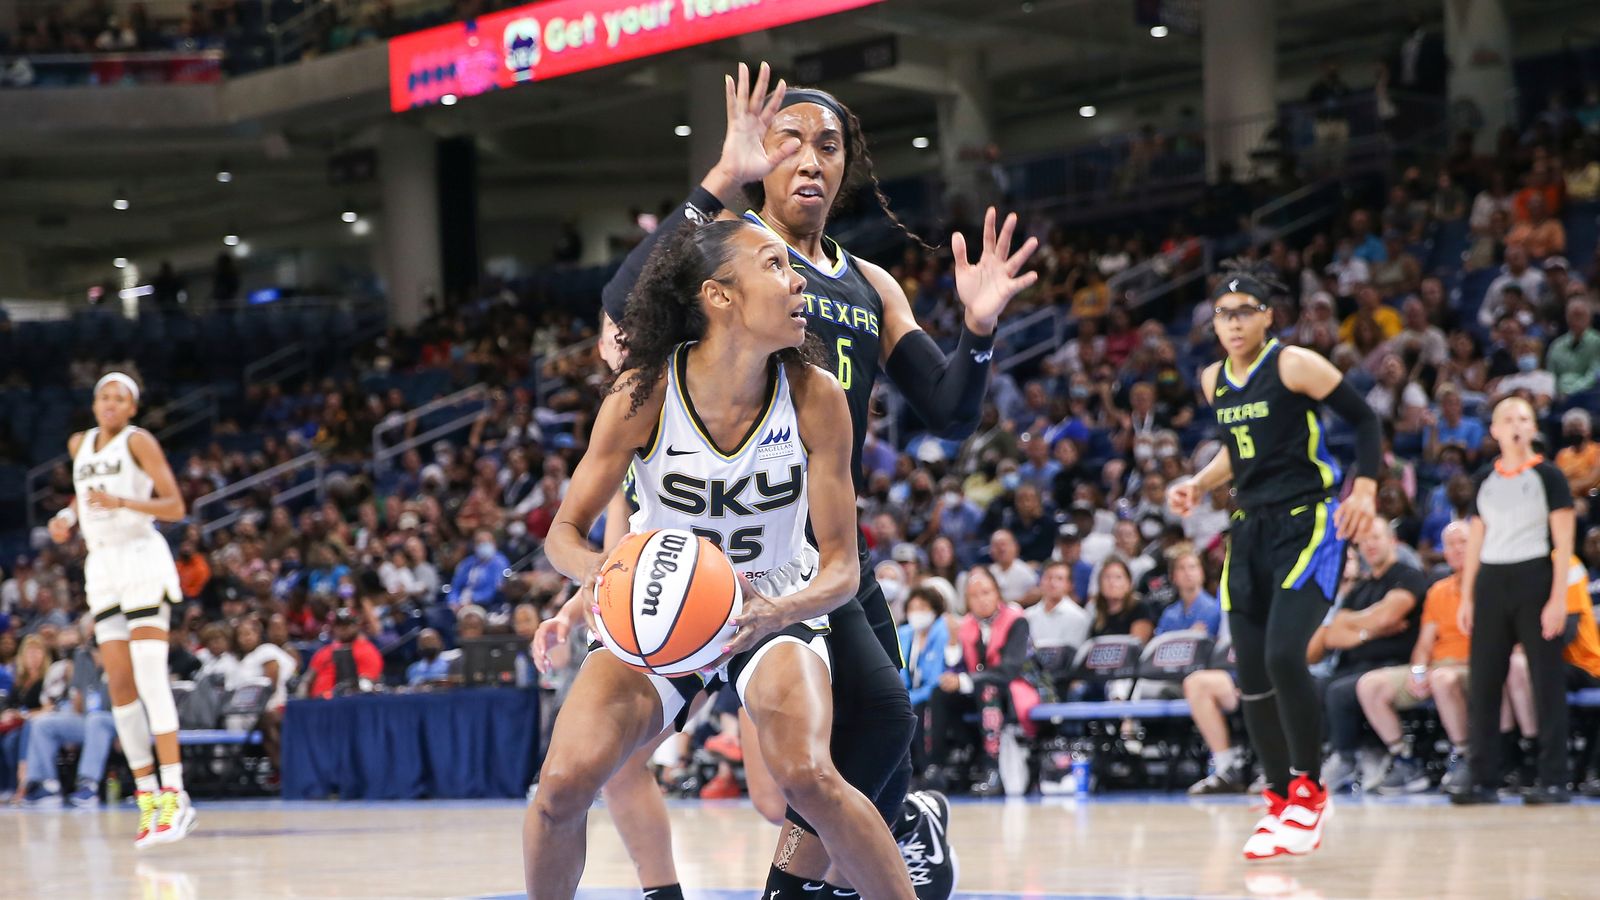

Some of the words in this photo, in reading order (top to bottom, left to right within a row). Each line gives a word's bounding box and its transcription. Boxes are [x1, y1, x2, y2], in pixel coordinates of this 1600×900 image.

[544, 12, 597, 52] Get
[602, 1, 674, 47] your
[801, 292, 879, 337] TEXAS
[1216, 401, 1269, 424] TEXAS
[758, 443, 793, 453] MAGELLAN
[1230, 425, 1255, 459] 15
[656, 464, 803, 518] SKY
[641, 534, 688, 616] Wilson
